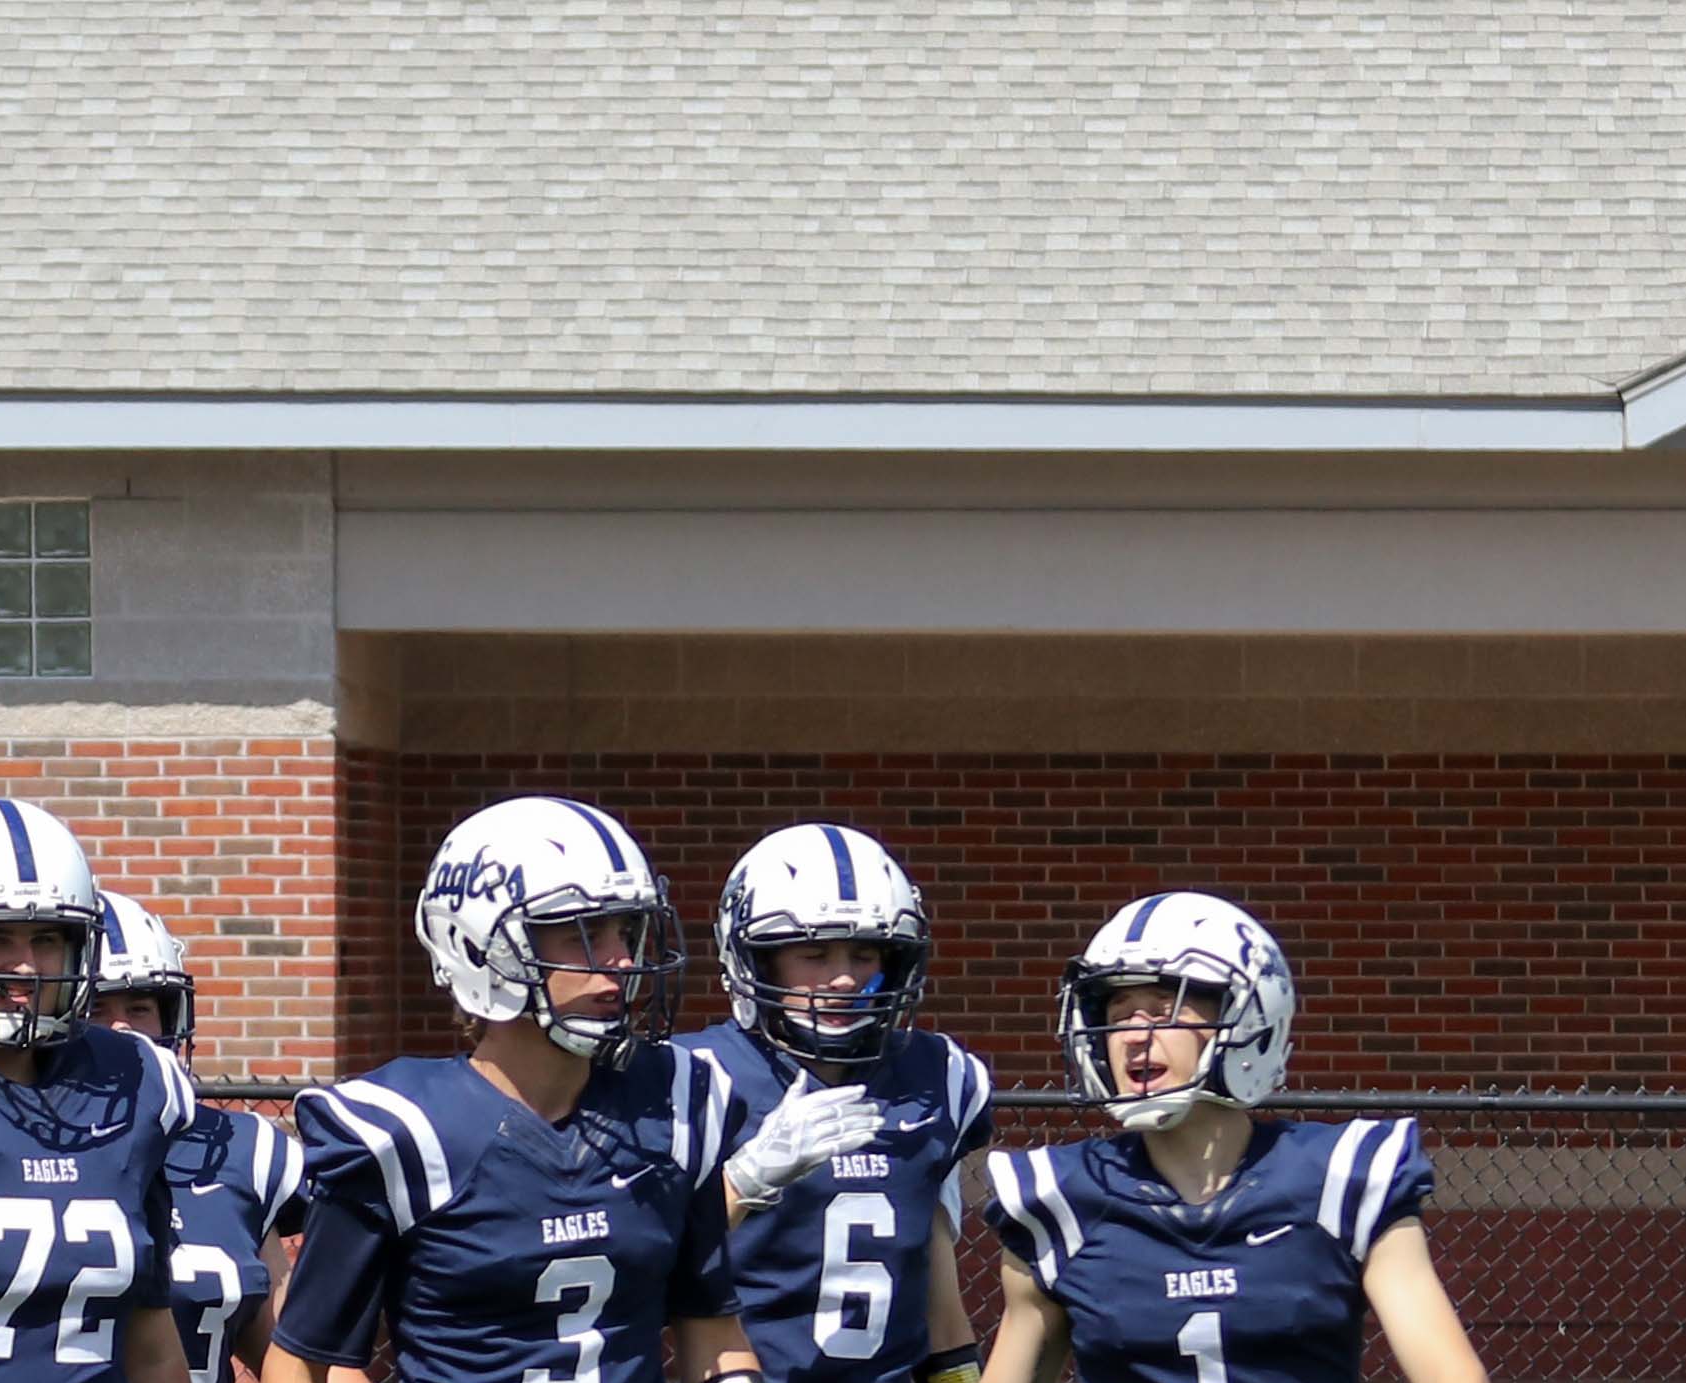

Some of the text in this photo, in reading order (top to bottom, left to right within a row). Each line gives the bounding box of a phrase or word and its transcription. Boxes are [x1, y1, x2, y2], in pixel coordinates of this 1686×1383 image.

[21, 1157, 80, 1184] EAGLES
[831, 1153, 891, 1180] EAGLES
[541, 1210, 611, 1245] EAGLES
[812, 1191, 897, 1360] 6
[1164, 1267, 1239, 1300] EAGLES
